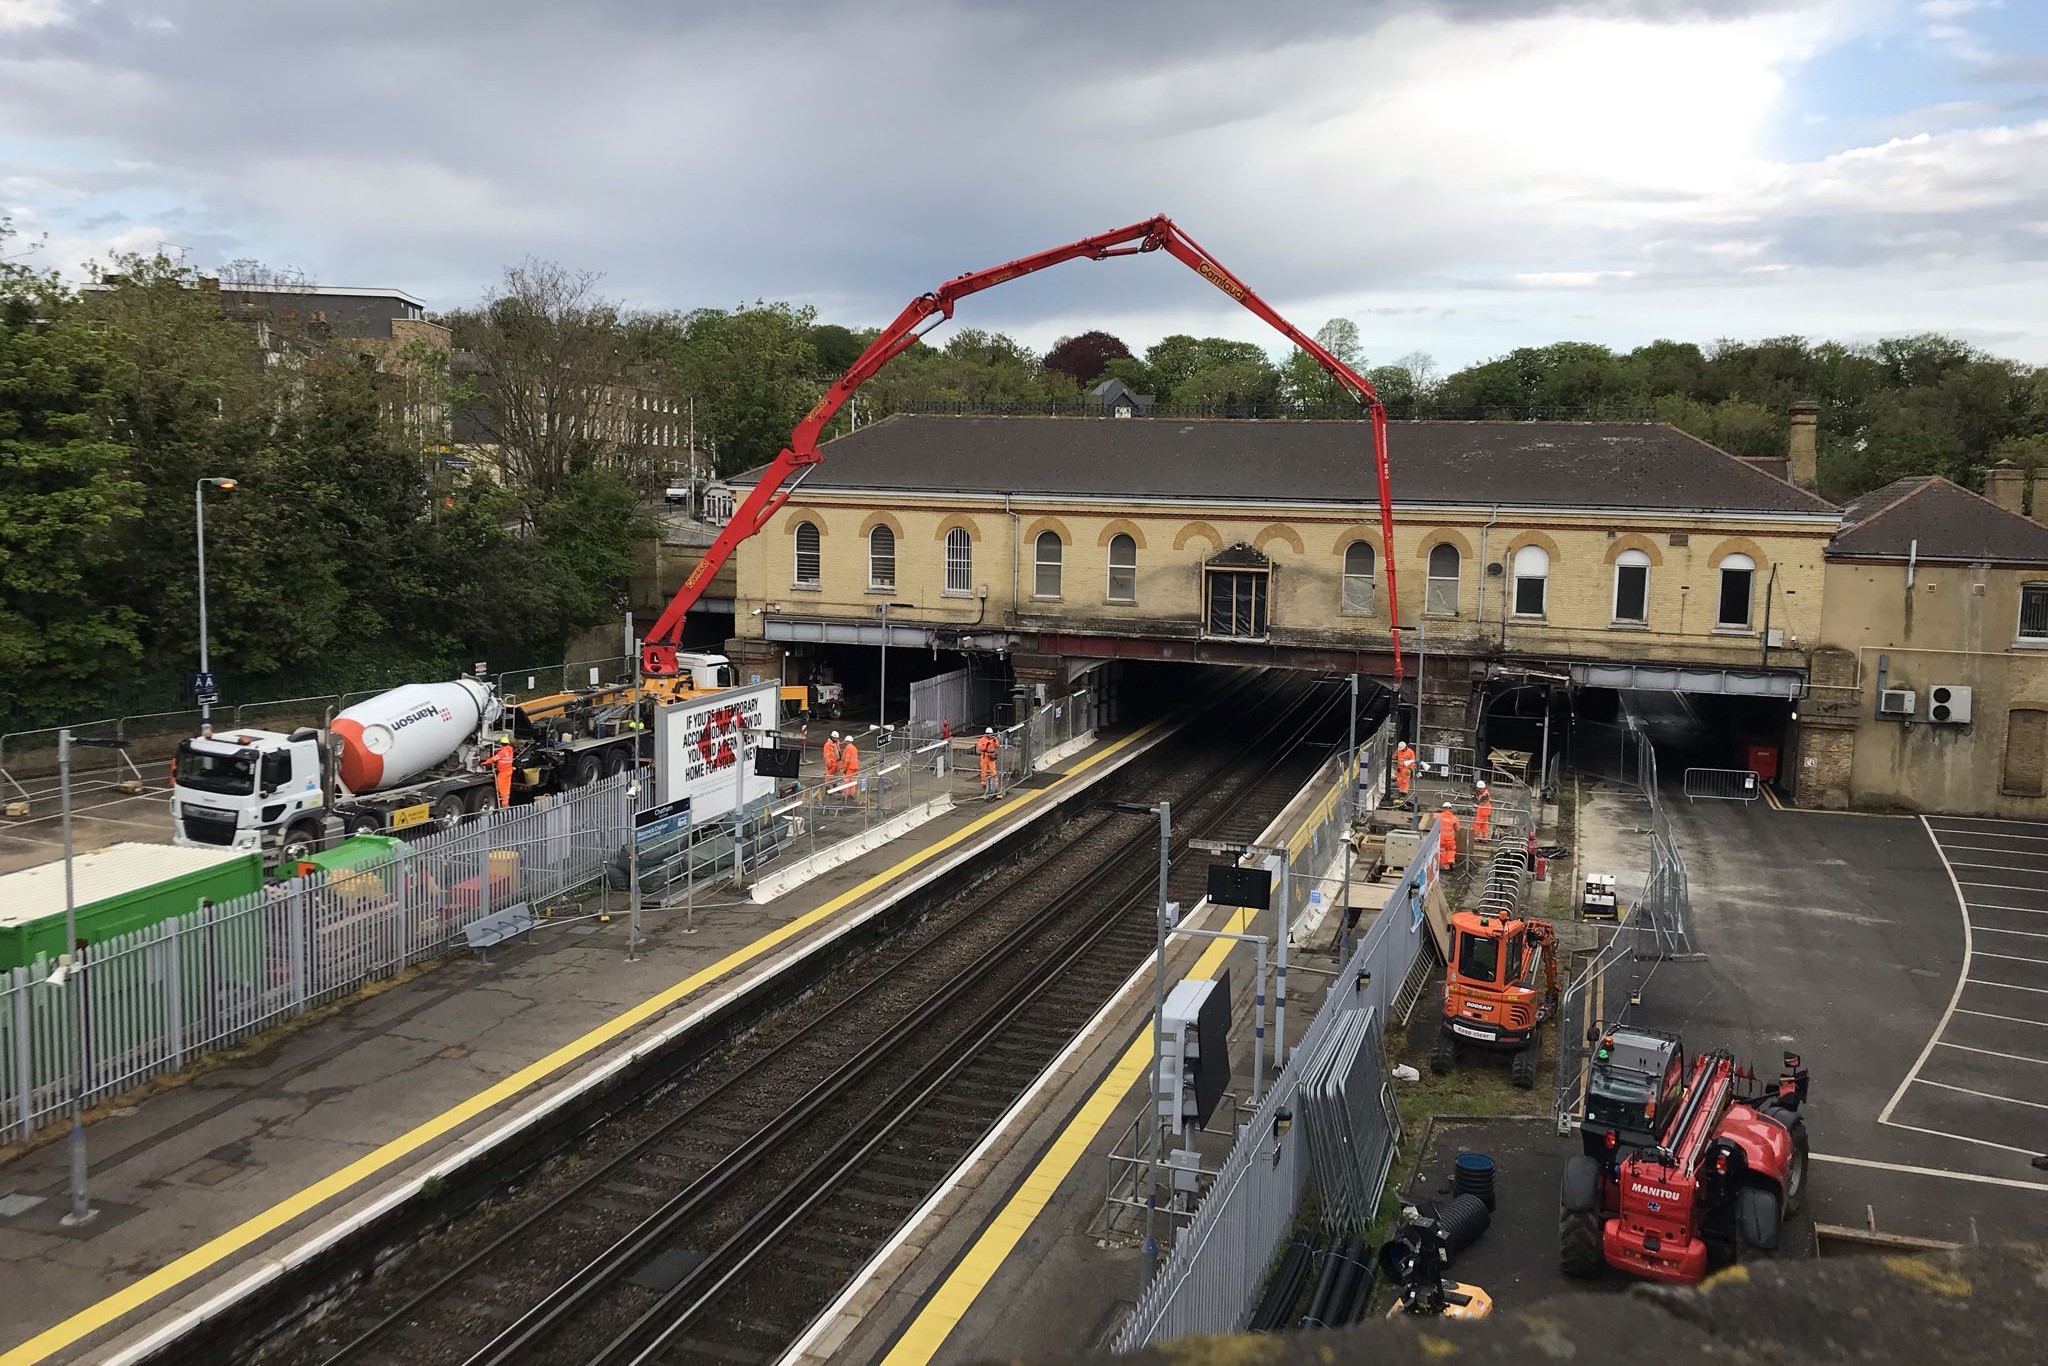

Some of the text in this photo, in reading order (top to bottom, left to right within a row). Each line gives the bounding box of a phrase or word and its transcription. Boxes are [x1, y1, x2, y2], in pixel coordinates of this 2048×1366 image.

[1199, 263, 1244, 299] Camfaud
[391, 705, 439, 731] Hanson
[686, 698, 759, 730] IF YOU'RE IN TEMPORARY
[754, 713, 762, 727] DO
[687, 747, 701, 763] YOU
[702, 742, 717, 760] FIND
[685, 763, 704, 782] HOME
[706, 758, 718, 775] FOR
[1466, 1001, 1493, 1011] DOOSAN
[1631, 1182, 1680, 1201] MANITOU
